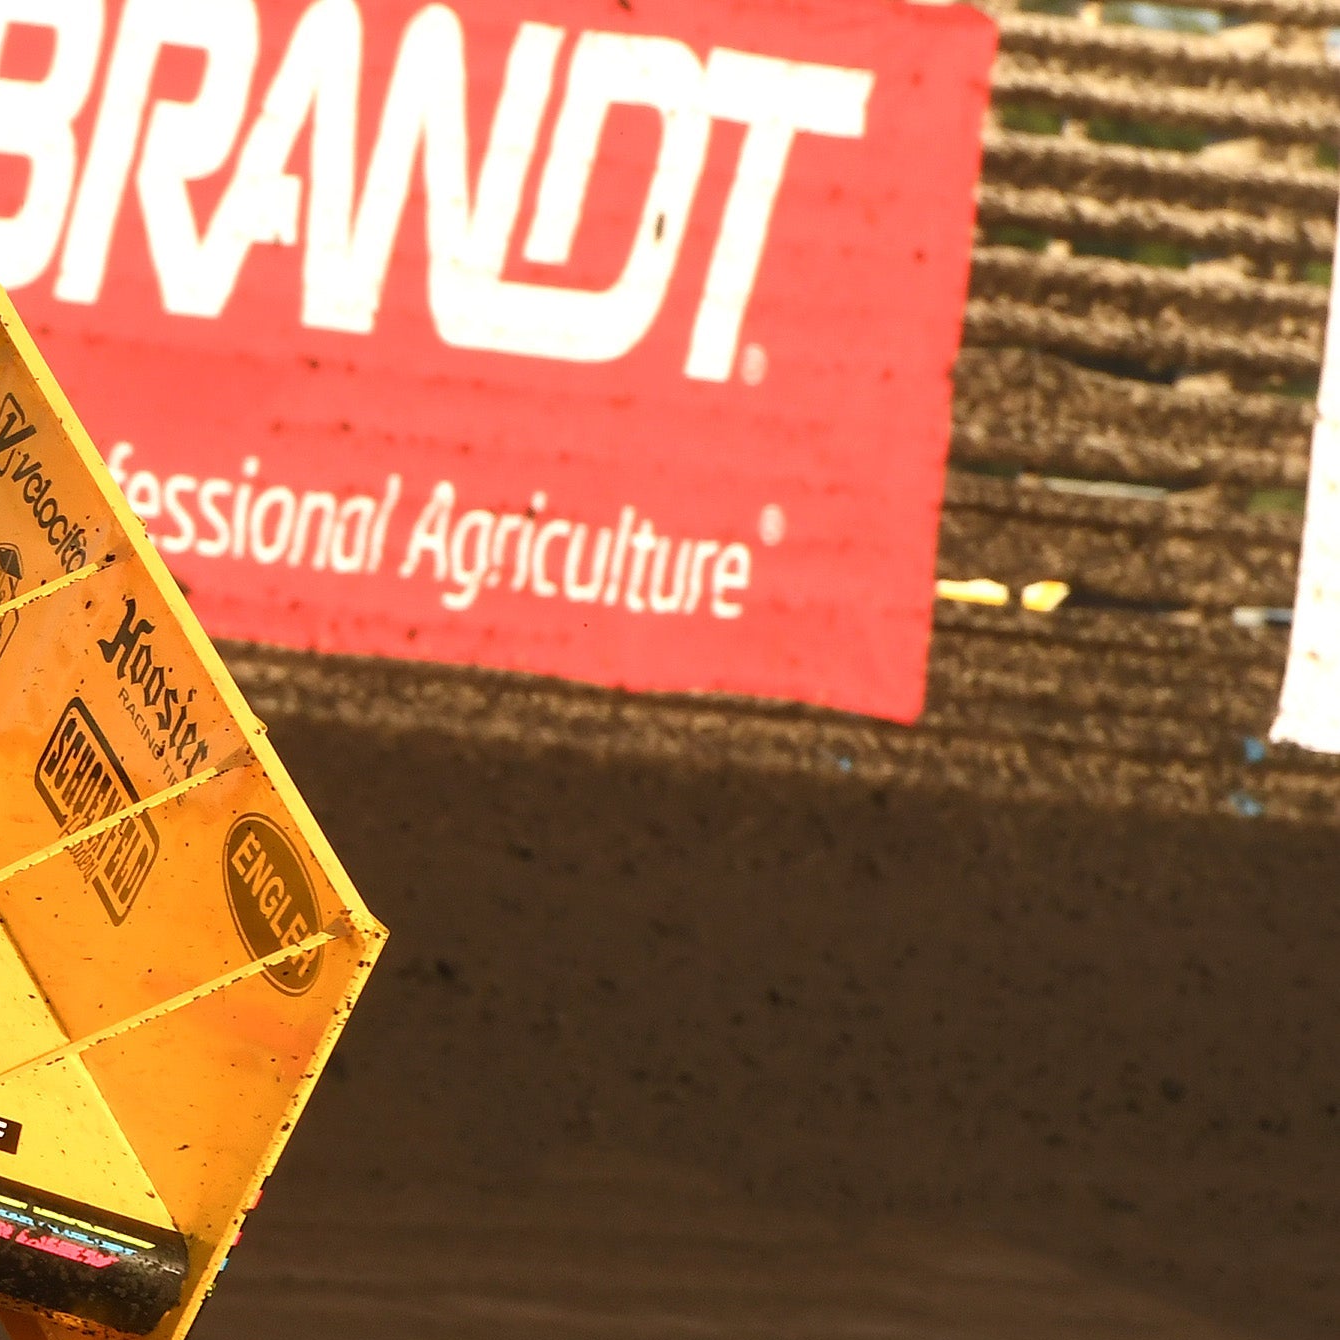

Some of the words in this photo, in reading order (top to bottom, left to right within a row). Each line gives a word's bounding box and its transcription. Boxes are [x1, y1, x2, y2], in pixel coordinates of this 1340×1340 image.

[400, 480, 750, 618] Agriculture
[114, 686, 165, 760] RACING
[231, 831, 320, 977] ENGLER
